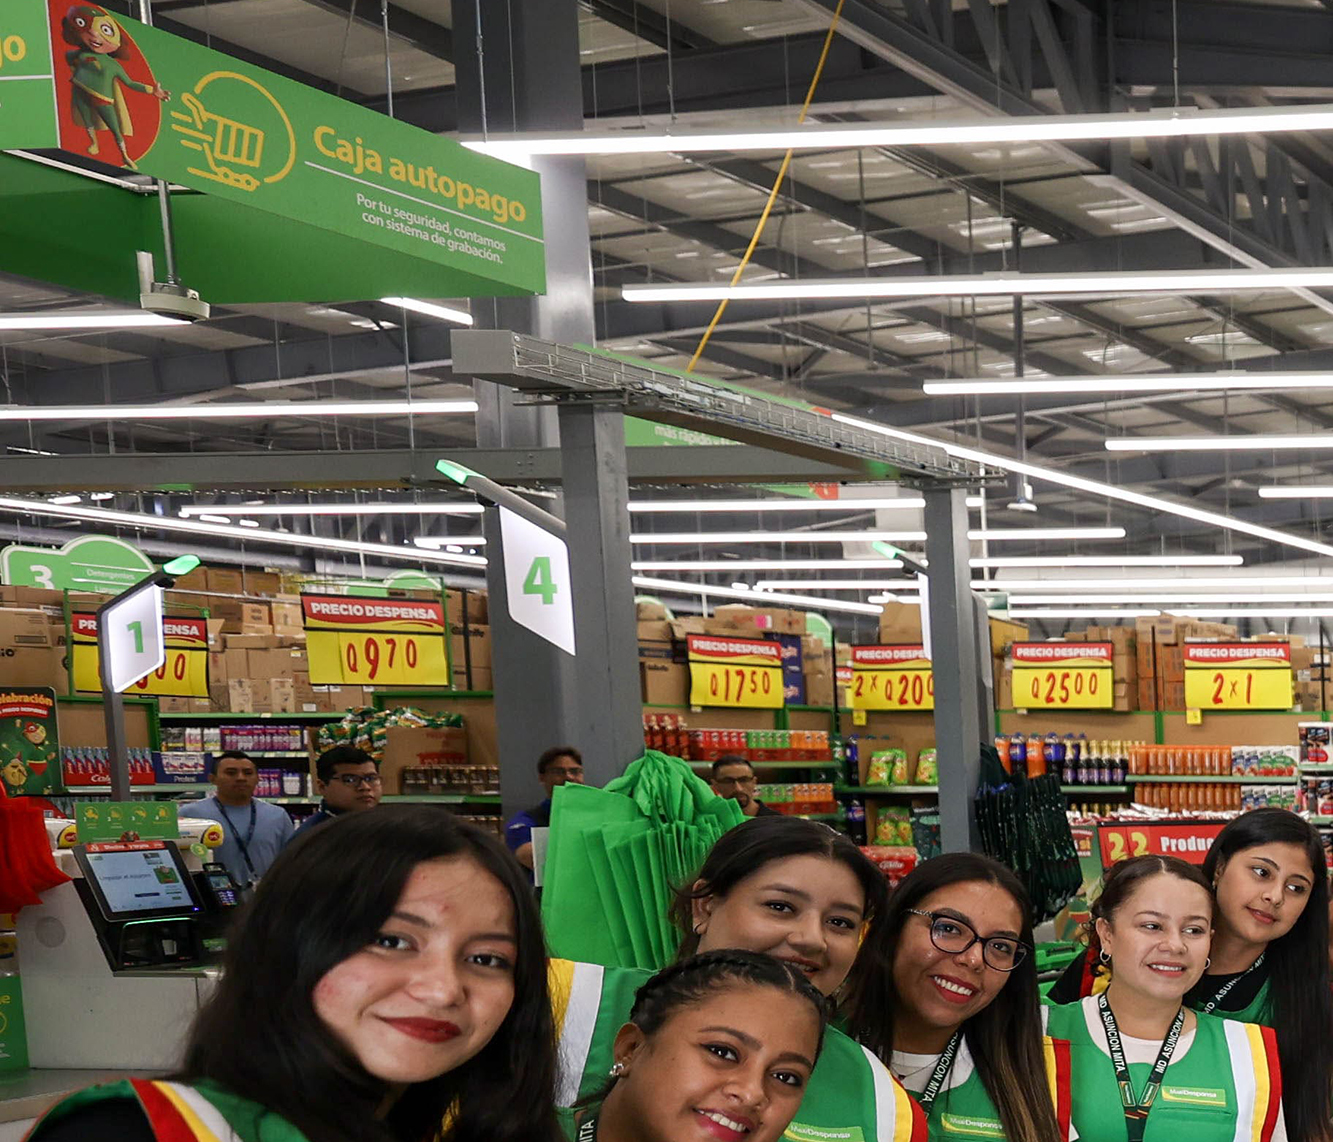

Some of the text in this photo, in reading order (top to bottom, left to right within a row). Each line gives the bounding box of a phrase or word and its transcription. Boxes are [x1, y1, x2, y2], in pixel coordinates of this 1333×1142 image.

[314, 126, 526, 222] Caja autopago
[356, 193, 506, 252] Por tu seguridad, contamos
[362, 213, 503, 264] con sistema de grabación.
[30, 565, 55, 589] 3
[523, 556, 557, 604] 4
[310, 602, 438, 620] PRECIO DESPENSA
[127, 621, 144, 654] 1
[163, 622, 199, 636] ENSA
[693, 639, 778, 657] PRECIO DESPENSA
[856, 649, 928, 660] PRECIO DESPE
[1017, 647, 1108, 658] PRECIO DESPENSA
[1189, 647, 1285, 658] PRECIO DESPENSA
[854, 674, 865, 698] 2
[1212, 673, 1253, 705] 2 1
[1104, 1008, 1121, 1052] ASUNCION
[1113, 1051, 1126, 1073] MITA
[921, 1031, 959, 1103] SUNCION MITA
[1153, 1058, 1168, 1074] MD
